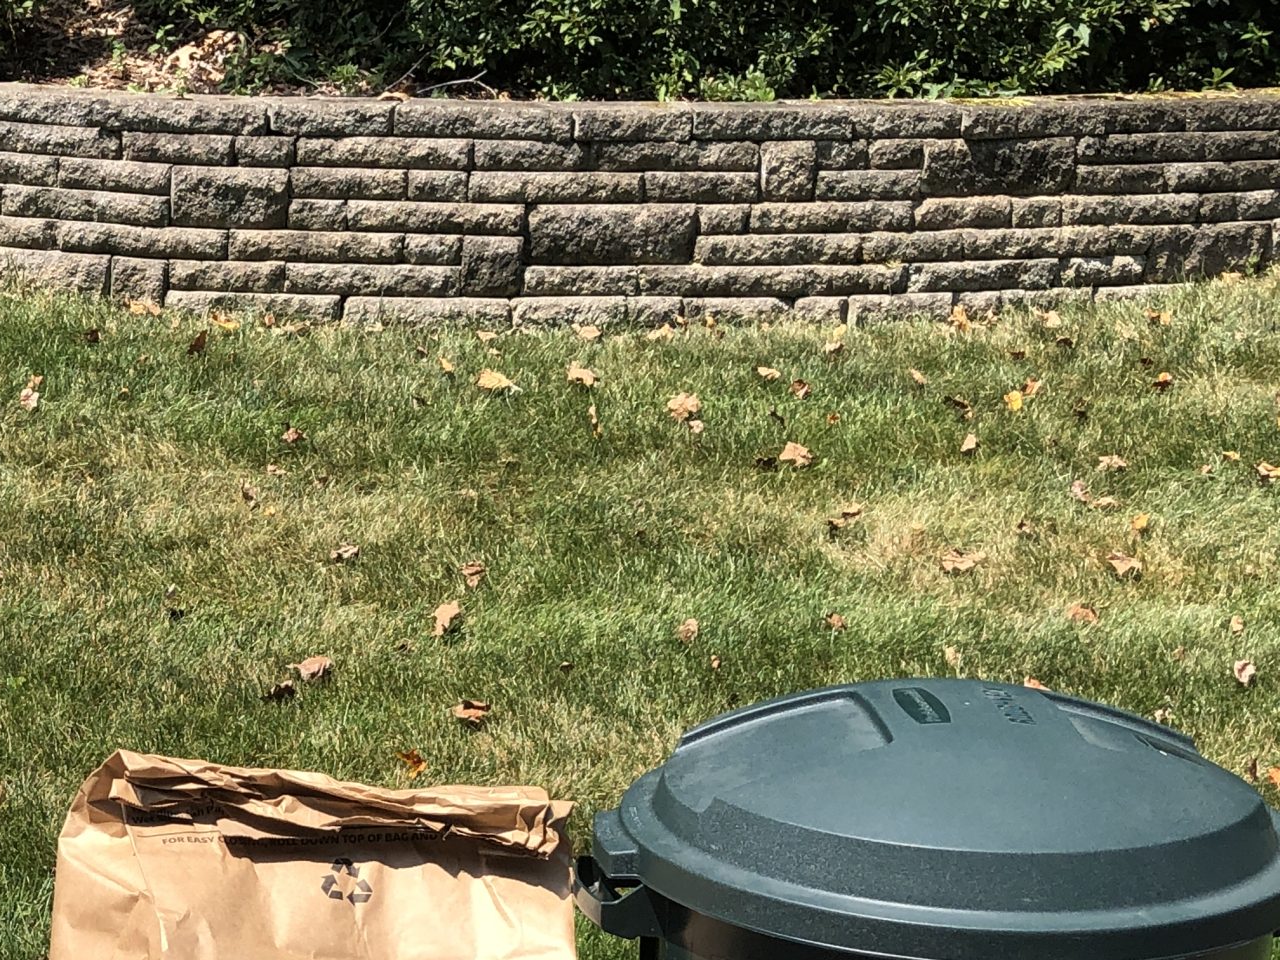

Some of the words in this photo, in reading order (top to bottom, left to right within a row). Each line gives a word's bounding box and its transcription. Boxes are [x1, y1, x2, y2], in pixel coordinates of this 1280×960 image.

[161, 836, 185, 845] FOR
[187, 836, 215, 844] EASY
[301, 835, 339, 846] DOWN
[342, 833, 365, 844] TOP
[367, 832, 381, 843] OF
[385, 832, 408, 842] BAG
[411, 831, 438, 841] AND
